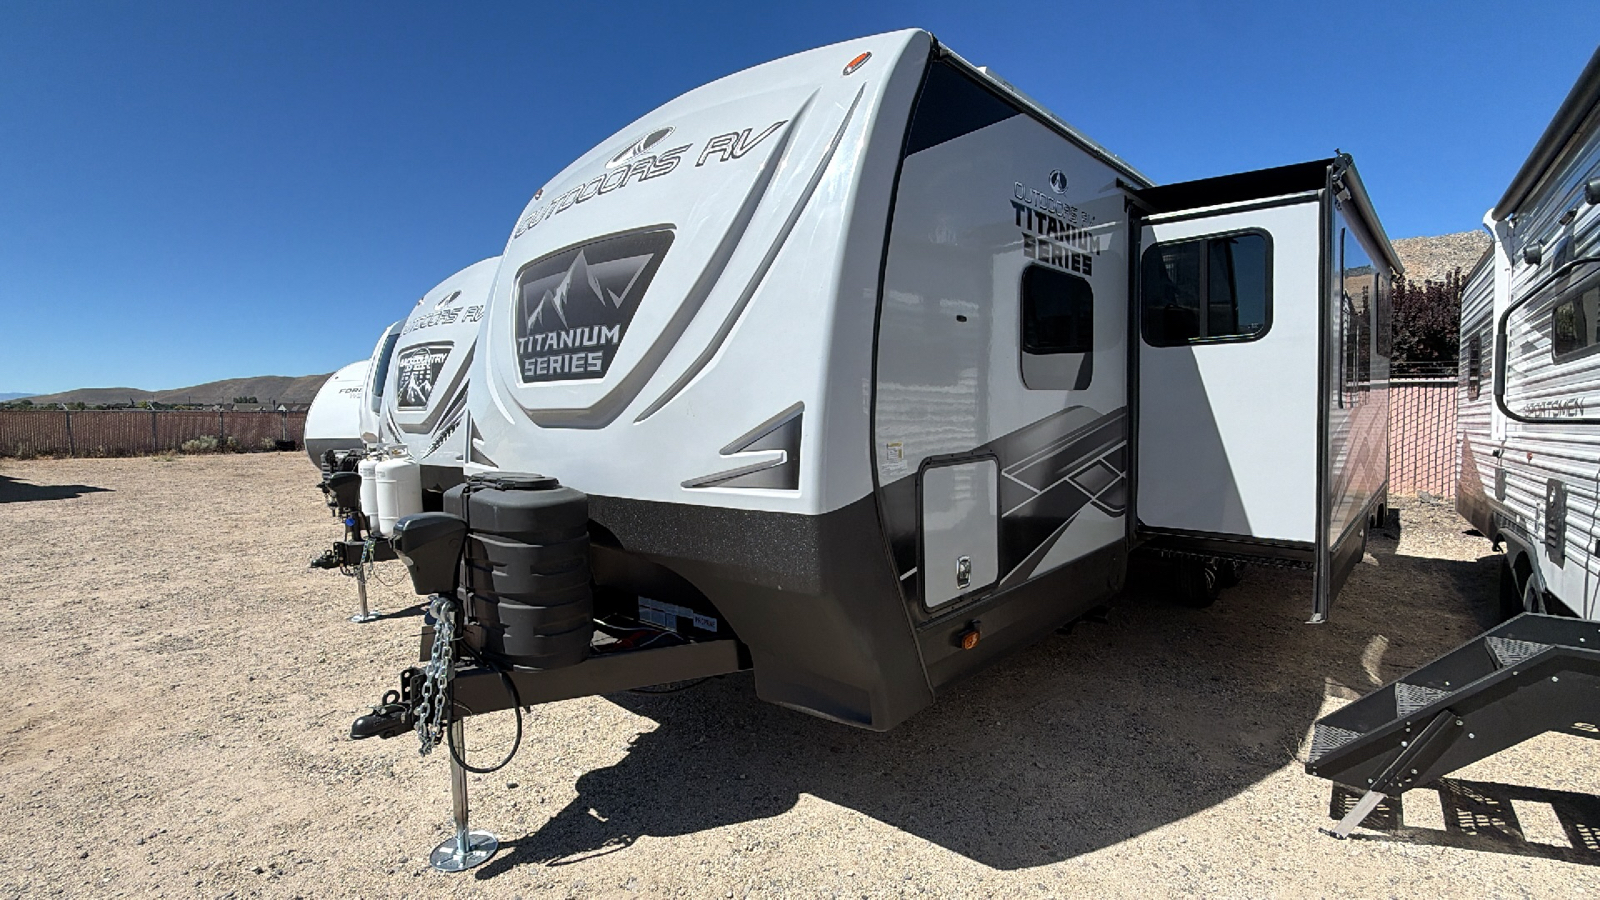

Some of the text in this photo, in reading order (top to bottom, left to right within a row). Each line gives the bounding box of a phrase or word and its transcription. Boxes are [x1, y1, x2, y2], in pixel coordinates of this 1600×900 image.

[514, 119, 789, 239] OUTDOORS RV
[1014, 181, 1078, 224] OUTDOORS
[1009, 199, 1100, 256] TITANIUM
[1021, 231, 1093, 277] SERIES
[518, 324, 621, 353] TITANIUM
[524, 350, 604, 377] SERIES
